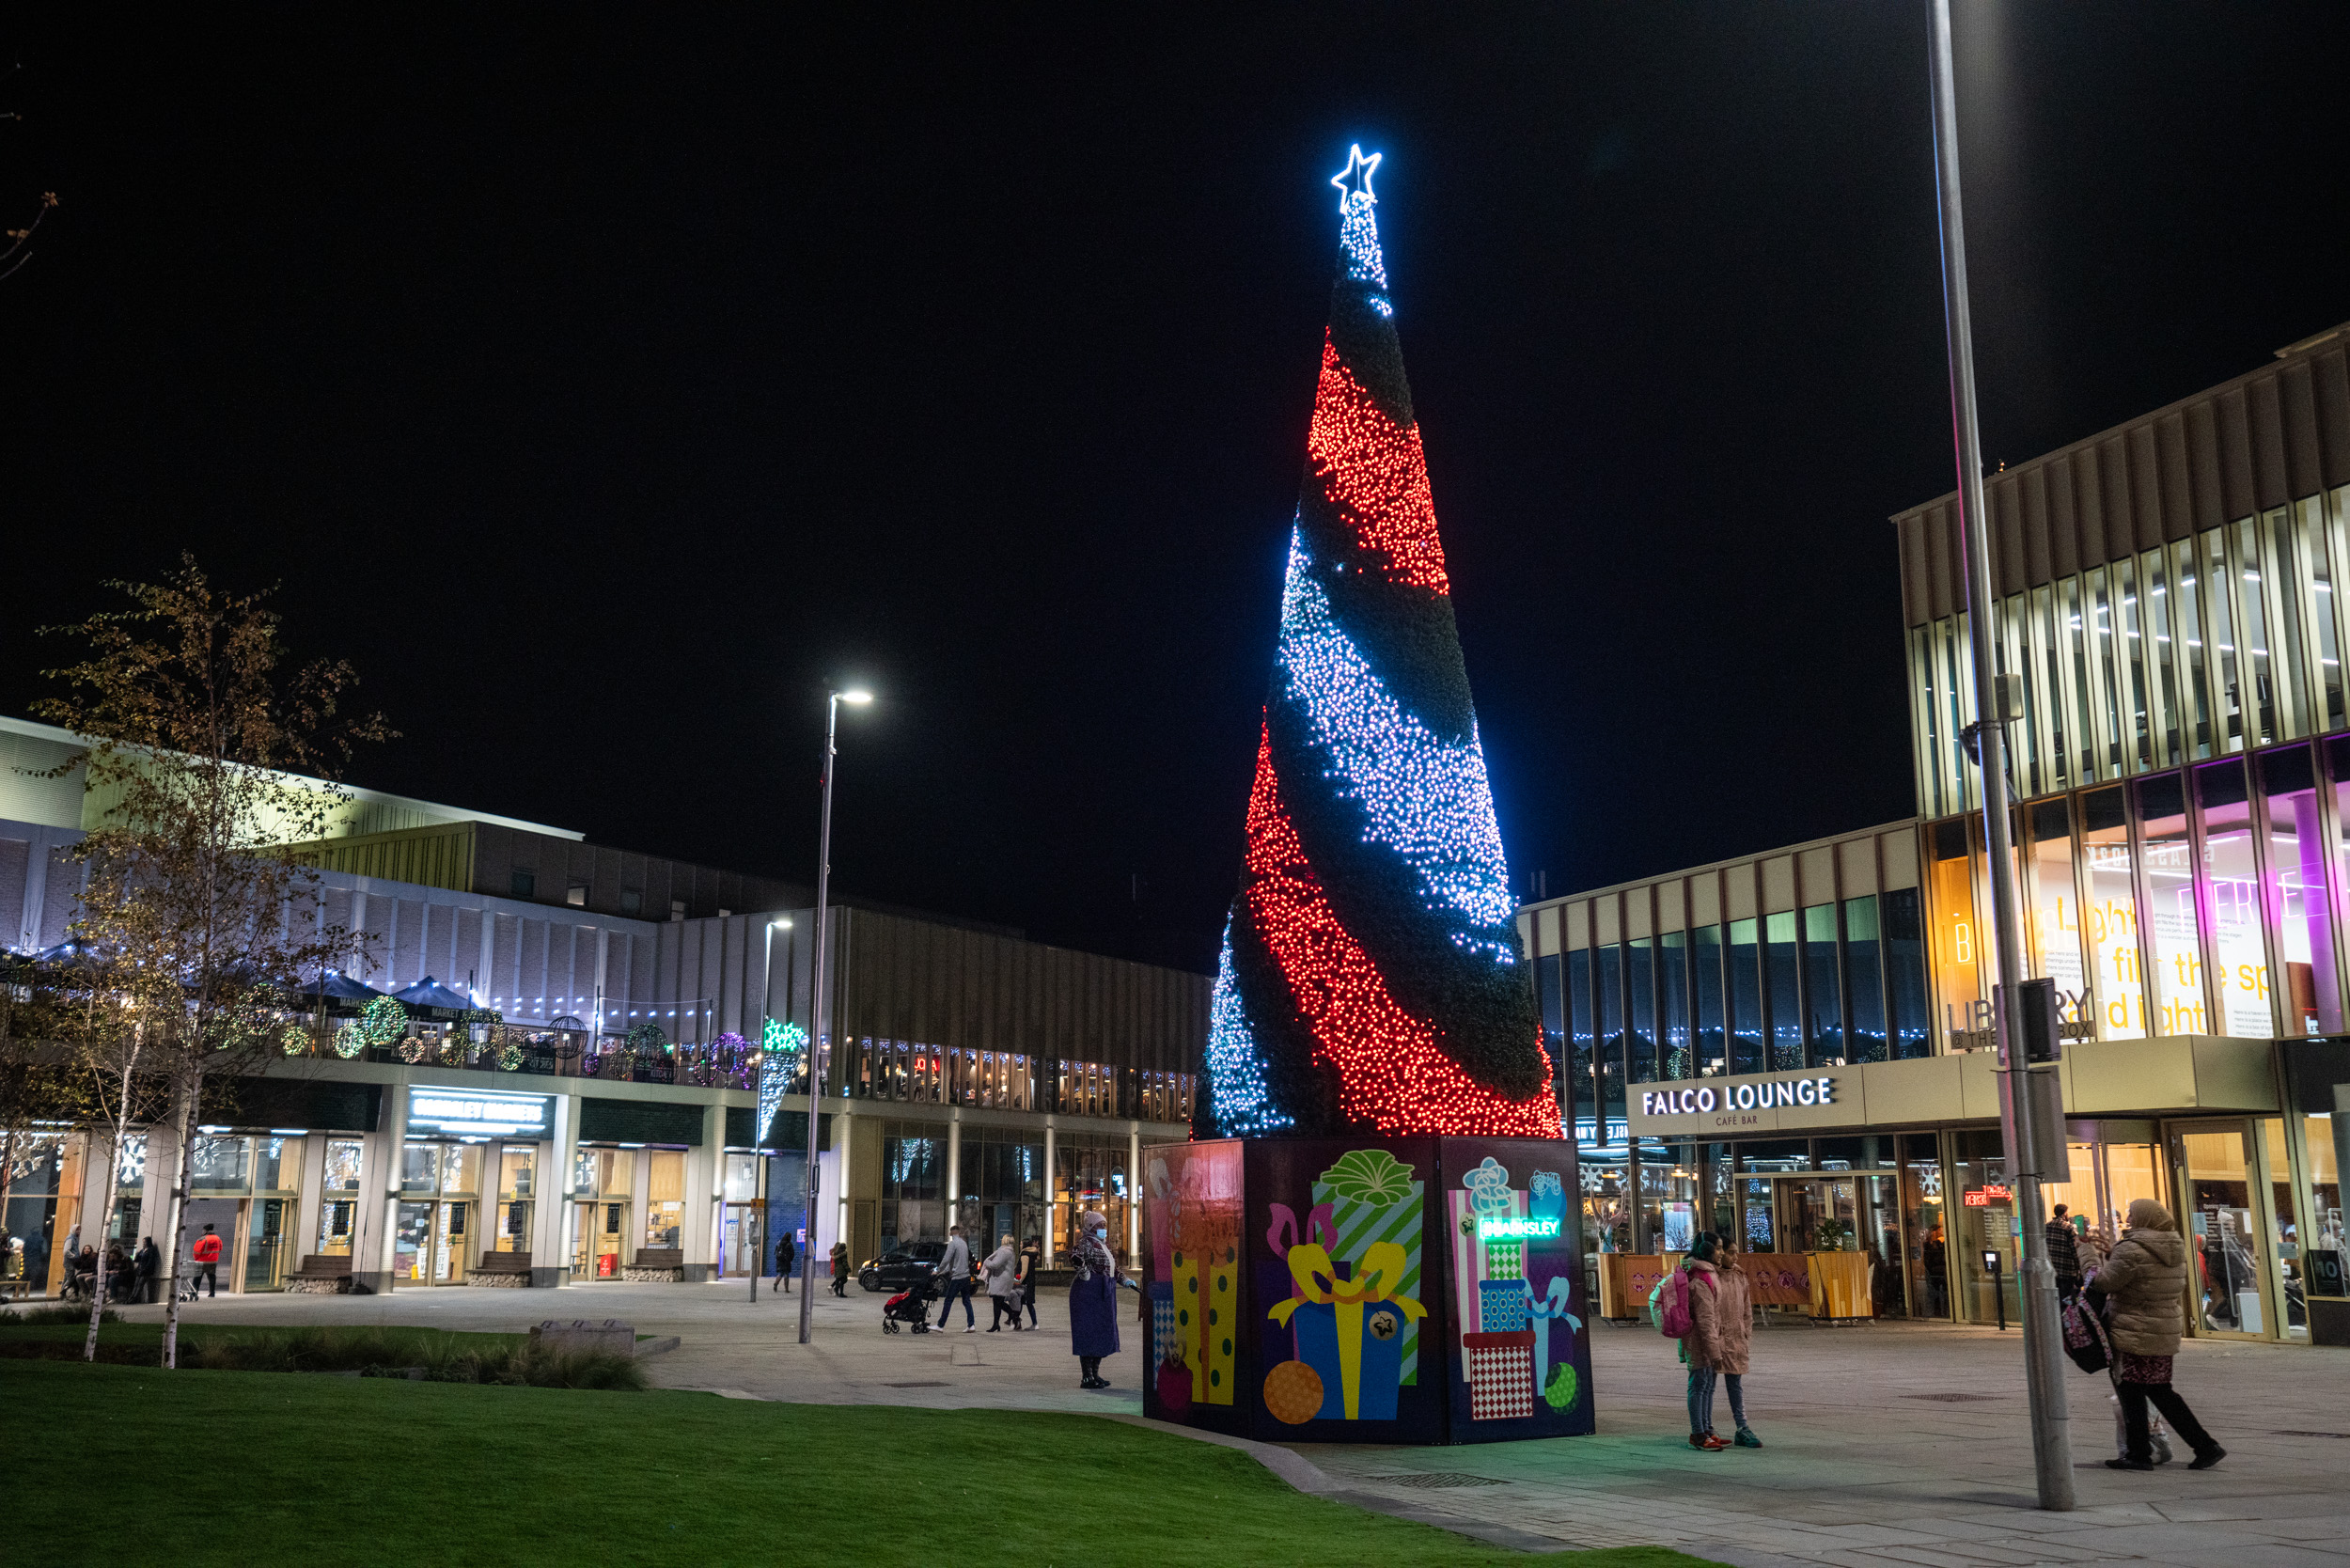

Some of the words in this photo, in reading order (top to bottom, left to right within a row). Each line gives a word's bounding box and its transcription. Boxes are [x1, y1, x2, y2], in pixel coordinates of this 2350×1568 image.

[431, 1007, 460, 1018] MARKET
[1951, 1032, 1964, 1047] @
[1643, 1088, 1715, 1116] FALCO
[1726, 1077, 1831, 1110] LOUNGE
[1716, 1114, 1737, 1127] CAFÉ
[1742, 1115, 1758, 1125] BAR
